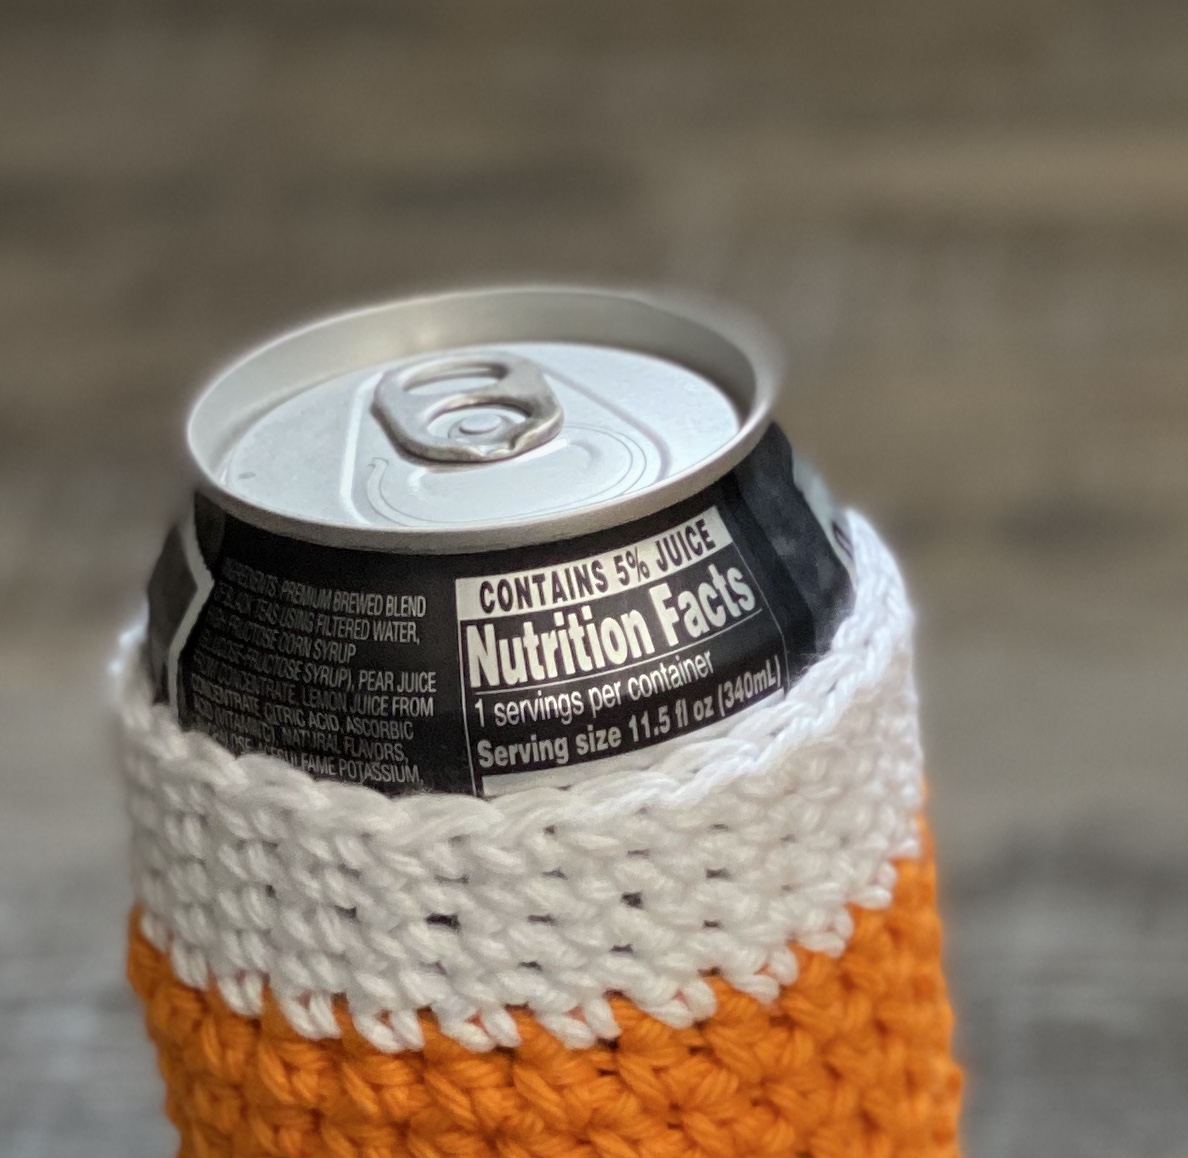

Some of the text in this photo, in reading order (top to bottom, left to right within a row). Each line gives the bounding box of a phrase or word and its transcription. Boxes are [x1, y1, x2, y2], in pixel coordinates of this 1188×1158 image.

[480, 519, 716, 614] CONTAINS 5% JUICE
[281, 579, 332, 611] PREMIUM
[333, 590, 383, 616] BREWED
[386, 594, 427, 618] BLEND
[316, 613, 370, 640] FILTERED
[372, 620, 420, 645] WATER,
[466, 563, 756, 688] Nutrition Facts
[278, 631, 312, 658] CORN
[312, 638, 356, 664] SYRUP
[358, 670, 394, 692] PEAR
[397, 671, 437, 693] JUICE
[475, 651, 714, 727] 1 servings per container
[263, 702, 305, 727] CITRIC
[346, 716, 414, 740] ASCORBIC
[302, 685, 347, 713] LEMON
[349, 693, 389, 717] JUICE
[391, 697, 434, 718] FROM
[477, 655, 781, 768] Serving size 11.5 fl oz (340mL)
[281, 726, 341, 755] NATURAL
[343, 736, 409, 765] FLAVORS,
